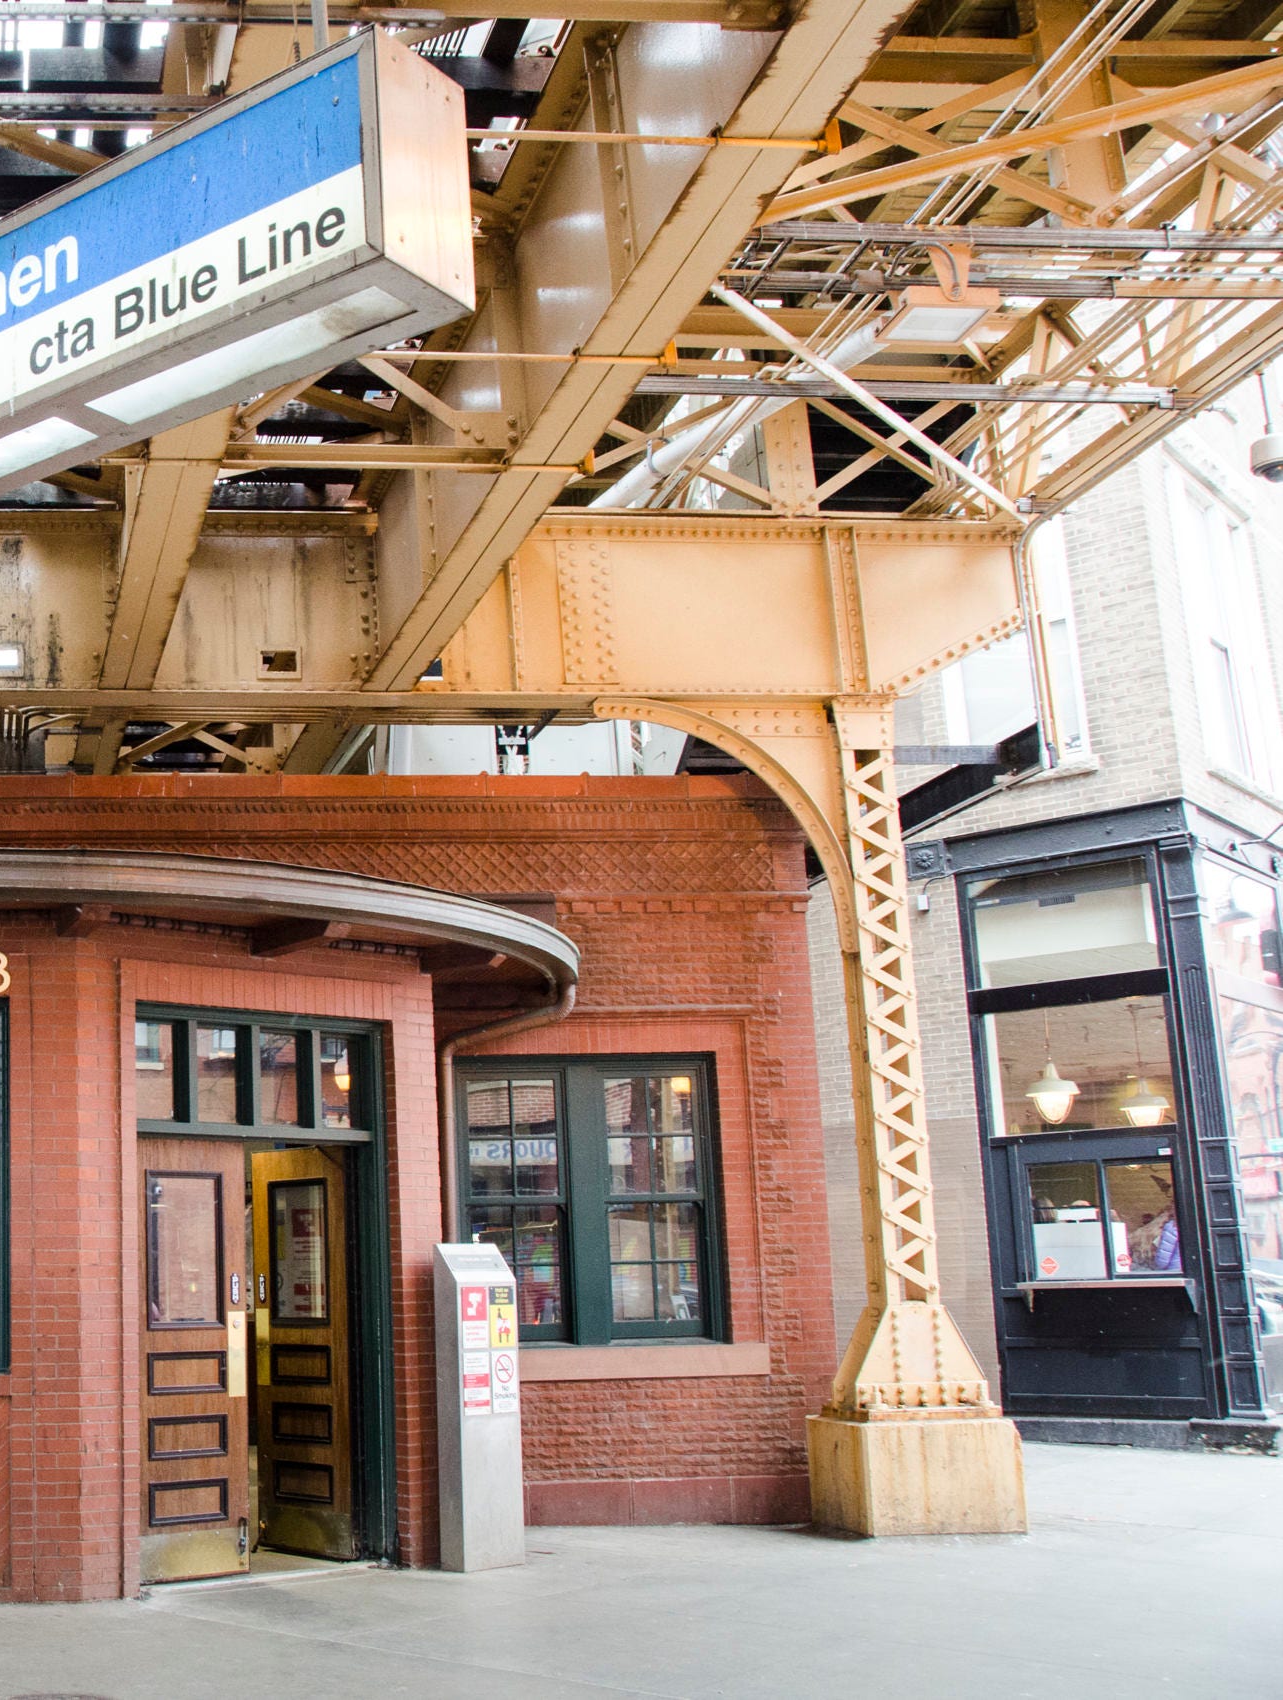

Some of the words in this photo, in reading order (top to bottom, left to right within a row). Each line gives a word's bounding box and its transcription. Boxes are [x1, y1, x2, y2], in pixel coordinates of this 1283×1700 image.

[29, 316, 96, 376] cta
[114, 264, 218, 340] Blue
[237, 207, 346, 285] Line
